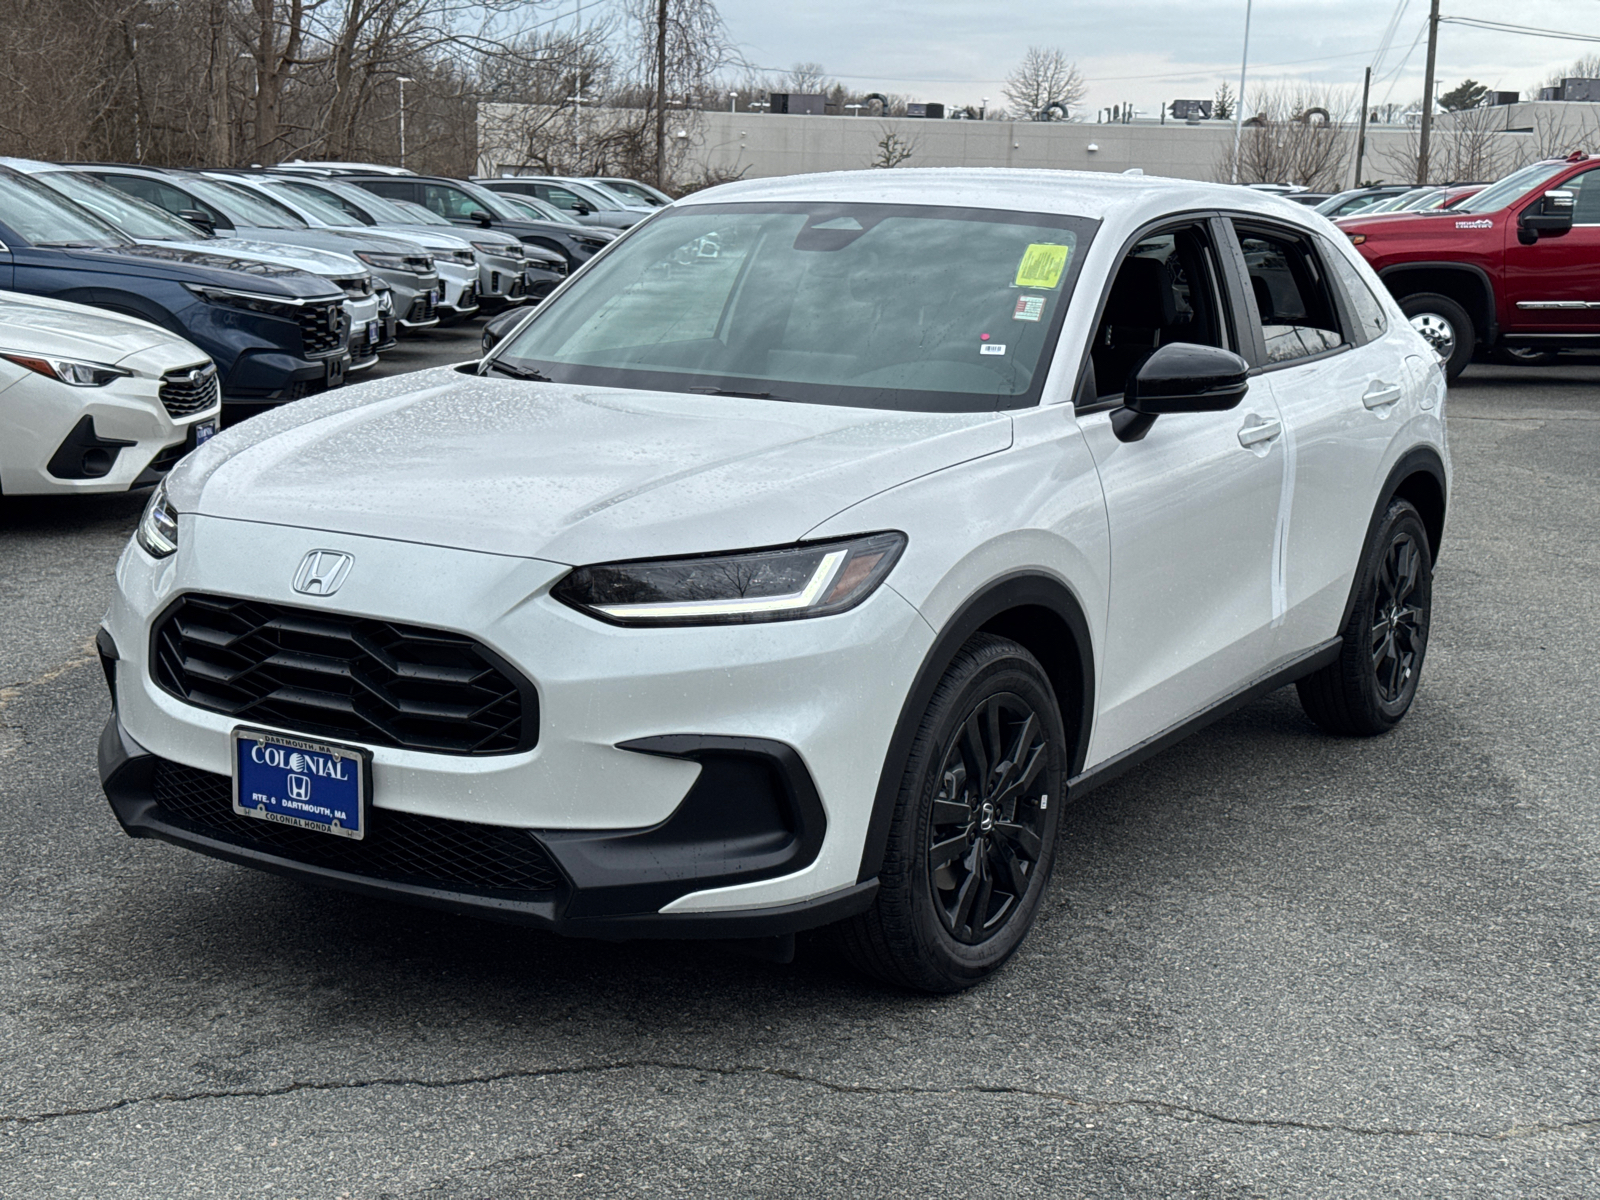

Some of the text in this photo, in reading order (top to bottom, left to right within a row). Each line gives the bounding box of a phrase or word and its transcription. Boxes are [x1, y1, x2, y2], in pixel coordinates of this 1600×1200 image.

[318, 745, 332, 754] MA
[251, 745, 348, 781] COLONIAL
[252, 793, 277, 805] RTE. 6
[281, 799, 347, 820] DARTMOUTH, MA
[265, 812, 332, 834] COLONIAL HONDA
